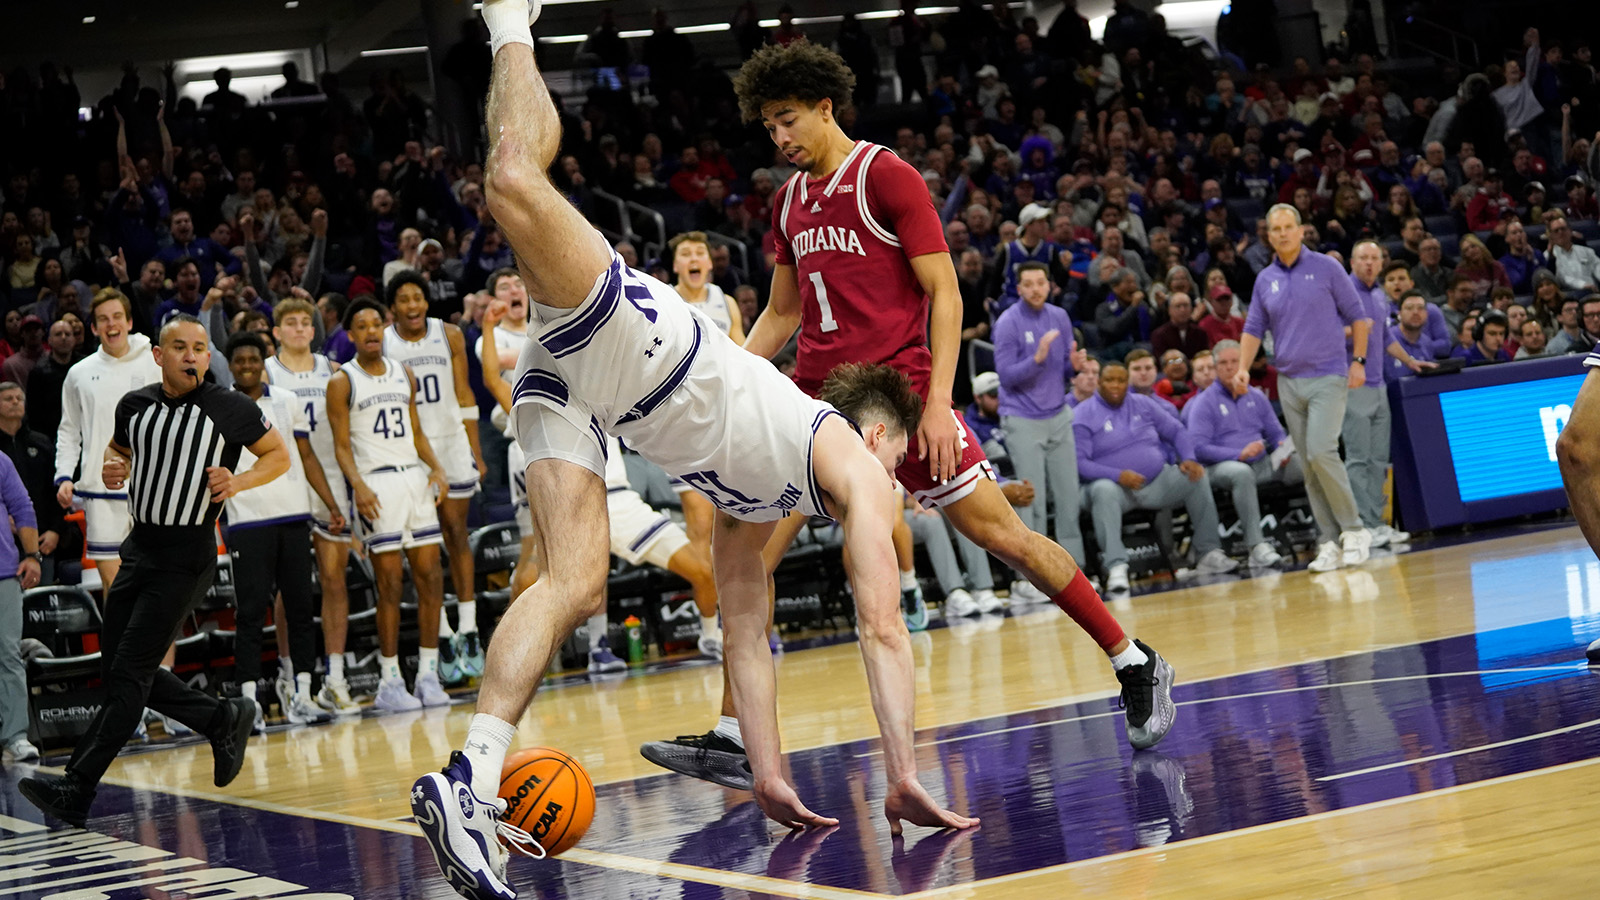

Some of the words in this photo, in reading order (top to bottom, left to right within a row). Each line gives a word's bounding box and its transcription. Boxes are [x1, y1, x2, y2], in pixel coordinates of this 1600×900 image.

[791, 225, 867, 260] NDIANA
[808, 271, 839, 333] 1
[373, 407, 405, 439] 43
